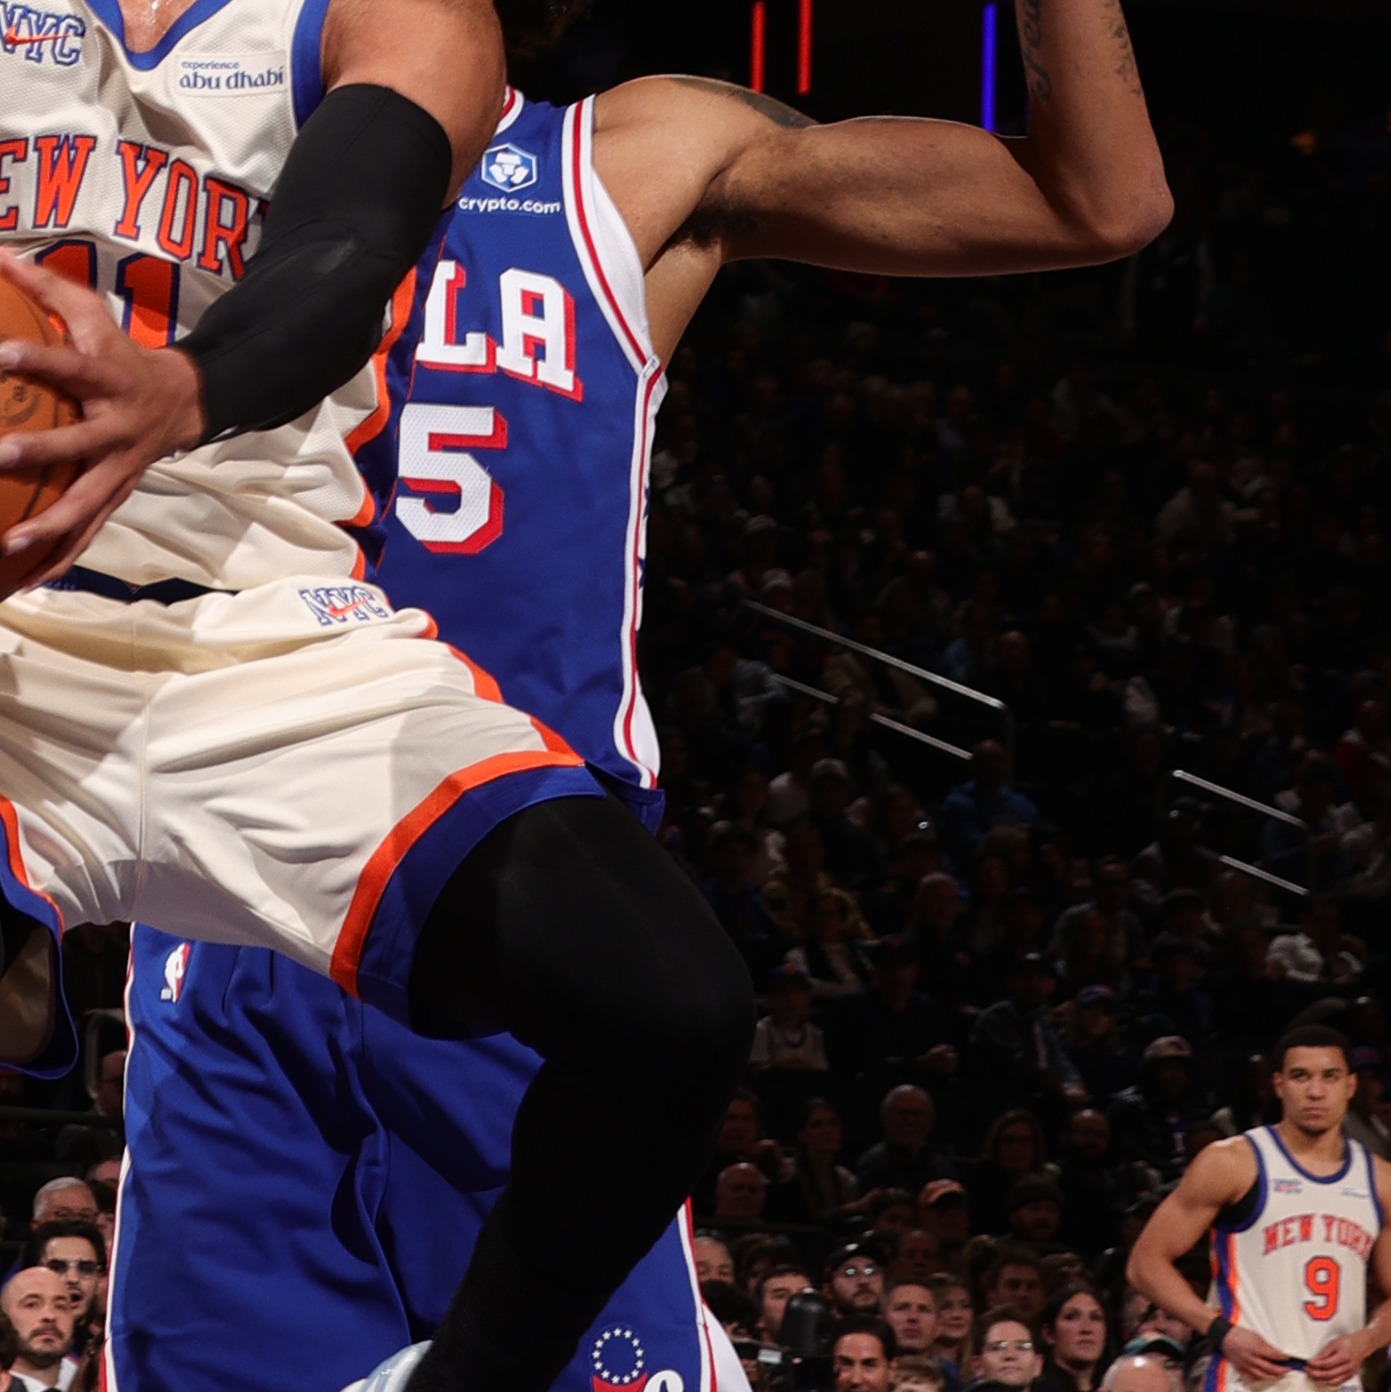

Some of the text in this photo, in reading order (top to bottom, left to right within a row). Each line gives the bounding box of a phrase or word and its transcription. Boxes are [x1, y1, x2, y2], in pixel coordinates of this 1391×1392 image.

[179, 66, 284, 90] abu dhabi
[181, 60, 240, 71] experience
[113, 139, 269, 283] YOR
[458, 196, 561, 214] crypto.com
[395, 402, 508, 555] 5
[299, 584, 389, 626] NYC
[1262, 1212, 1315, 1255] NEW
[1303, 1254, 1341, 1321] 9
